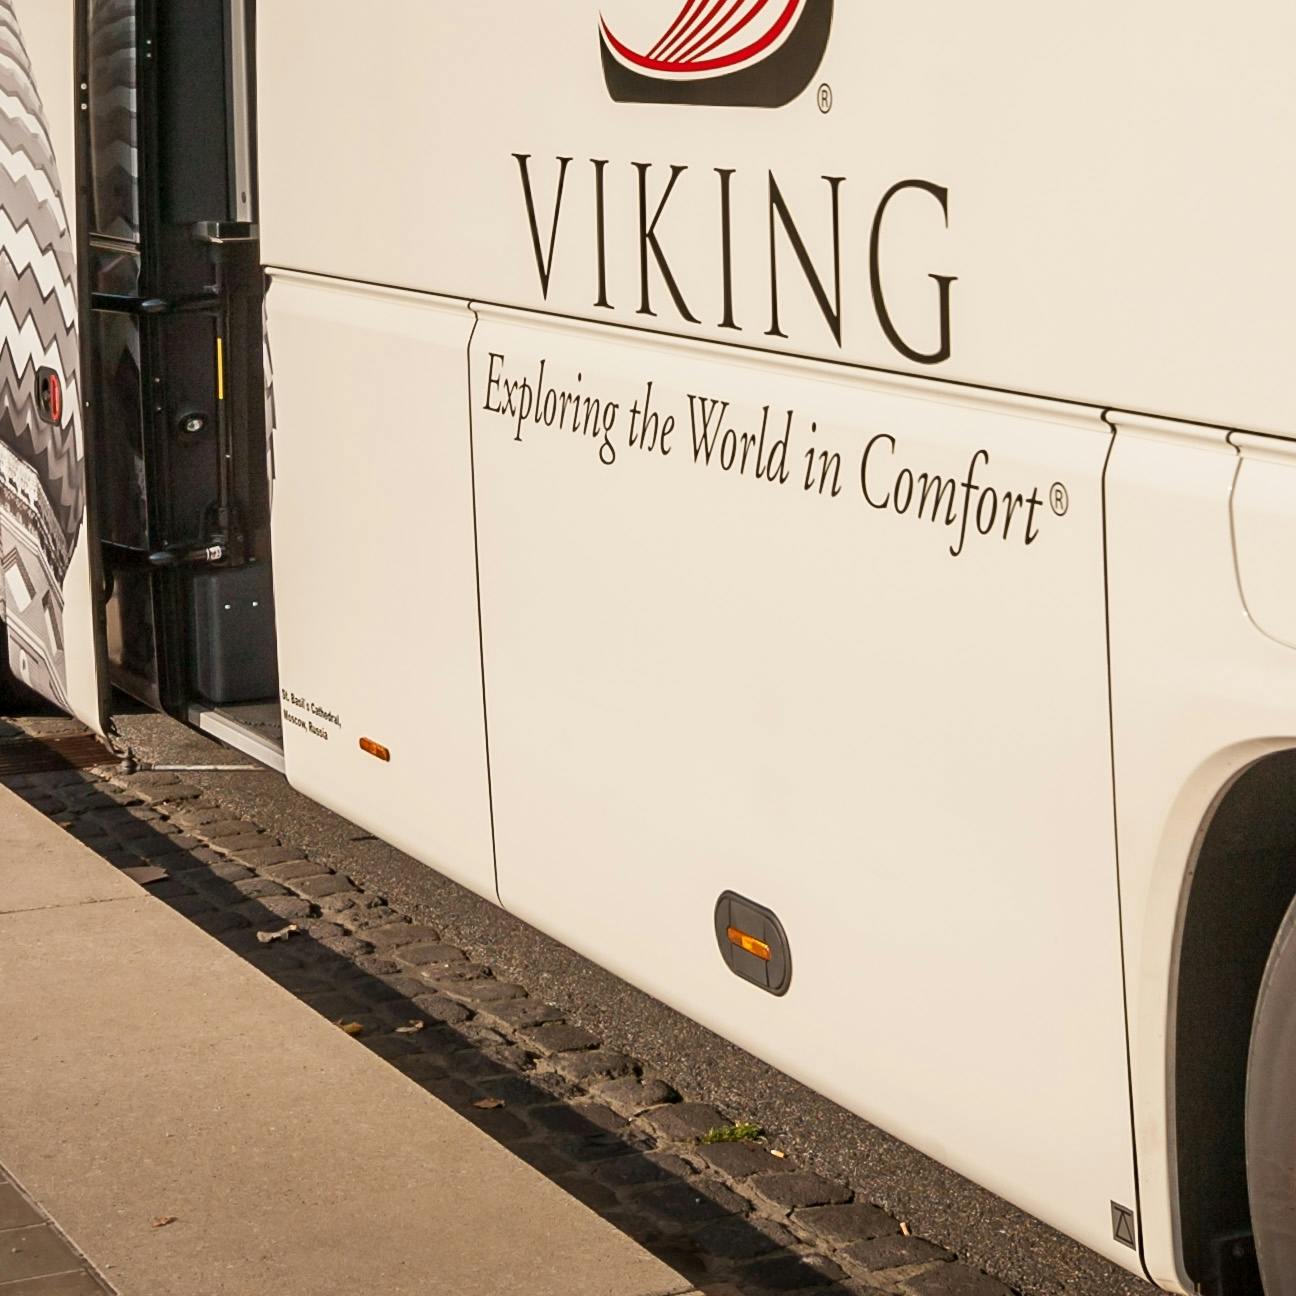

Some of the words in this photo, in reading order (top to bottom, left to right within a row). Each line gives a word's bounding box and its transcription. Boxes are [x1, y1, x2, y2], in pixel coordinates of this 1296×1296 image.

[511, 153, 959, 366] VIKING
[482, 351, 620, 466] Exploring
[628, 380, 677, 458] the
[686, 393, 795, 486] World
[804, 421, 843, 499] in
[283, 708, 308, 733] Moscow,
[308, 720, 329, 741] Russia
[310, 702, 342, 728] Cathedral,
